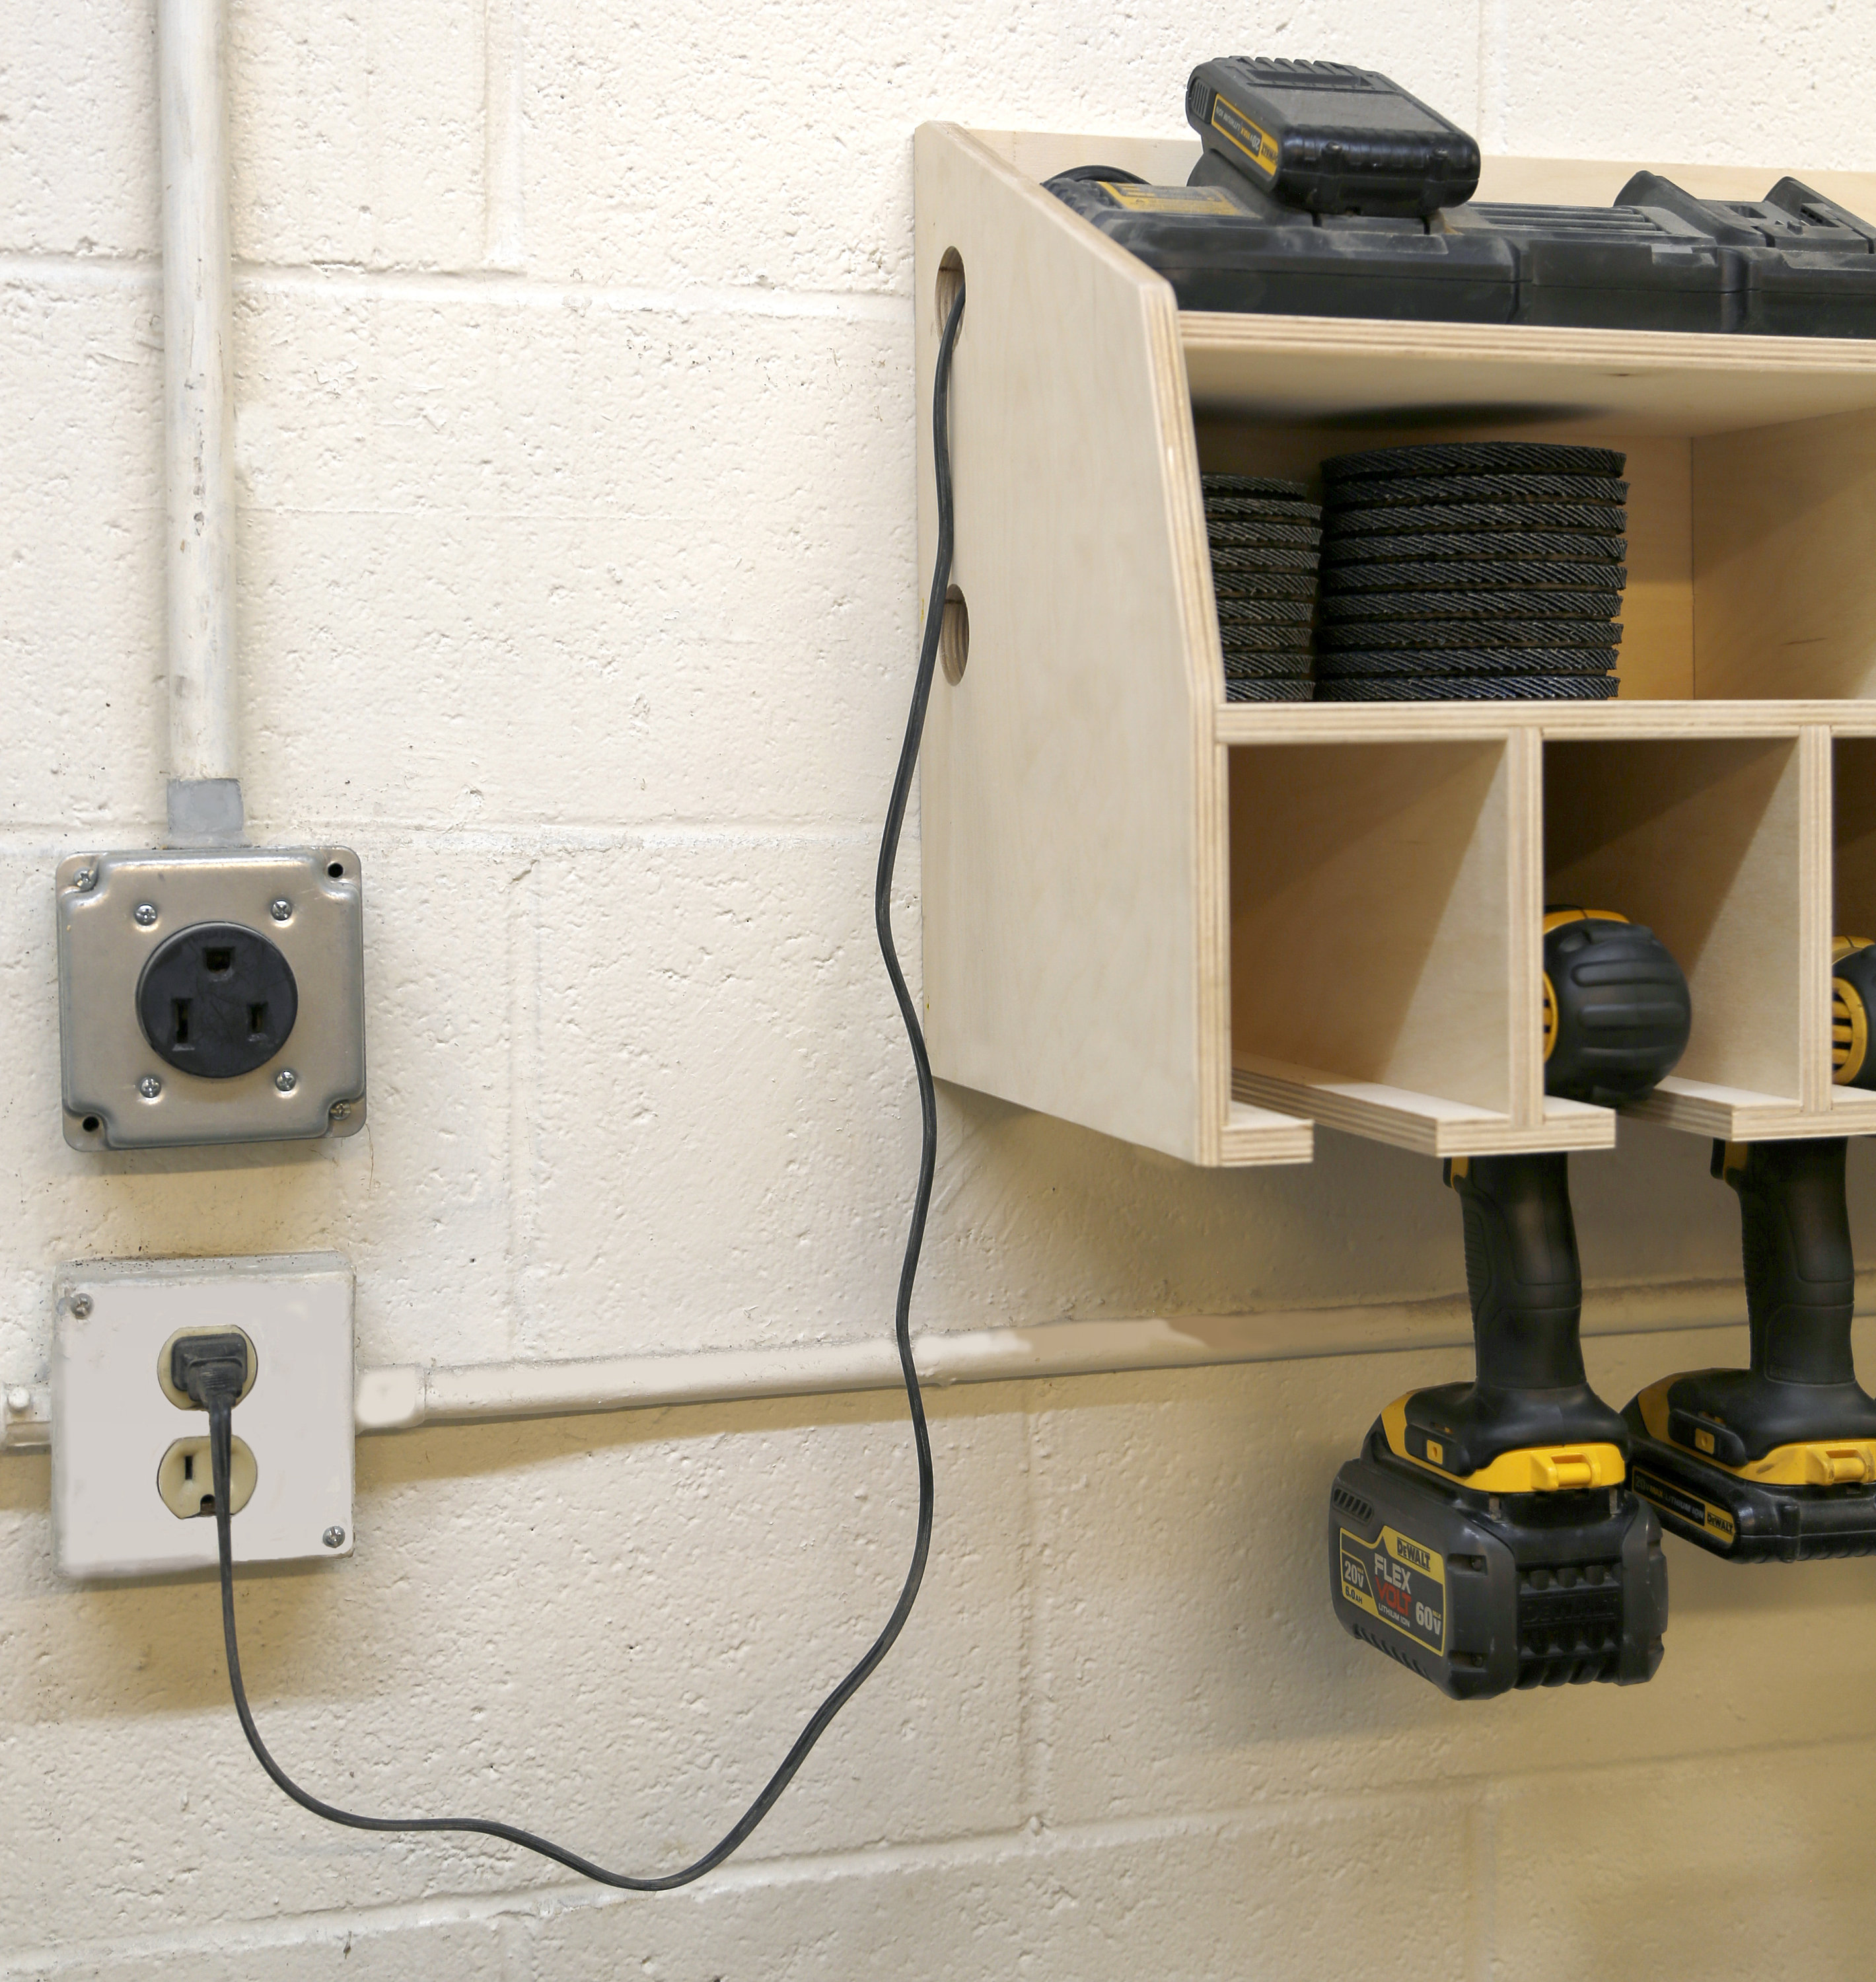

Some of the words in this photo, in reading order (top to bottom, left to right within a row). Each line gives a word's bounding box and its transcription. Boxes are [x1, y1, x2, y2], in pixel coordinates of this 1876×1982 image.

[1225, 115, 1241, 131] LITHIUM
[1665, 1493, 1690, 1512] LITHIUM
[1691, 1506, 1700, 1520] ION
[1375, 1553, 1411, 1594] FLEX
[1375, 1576, 1411, 1616] VOLT
[1378, 1603, 1399, 1622] LITHIUM
[1400, 1615, 1410, 1628] ION
